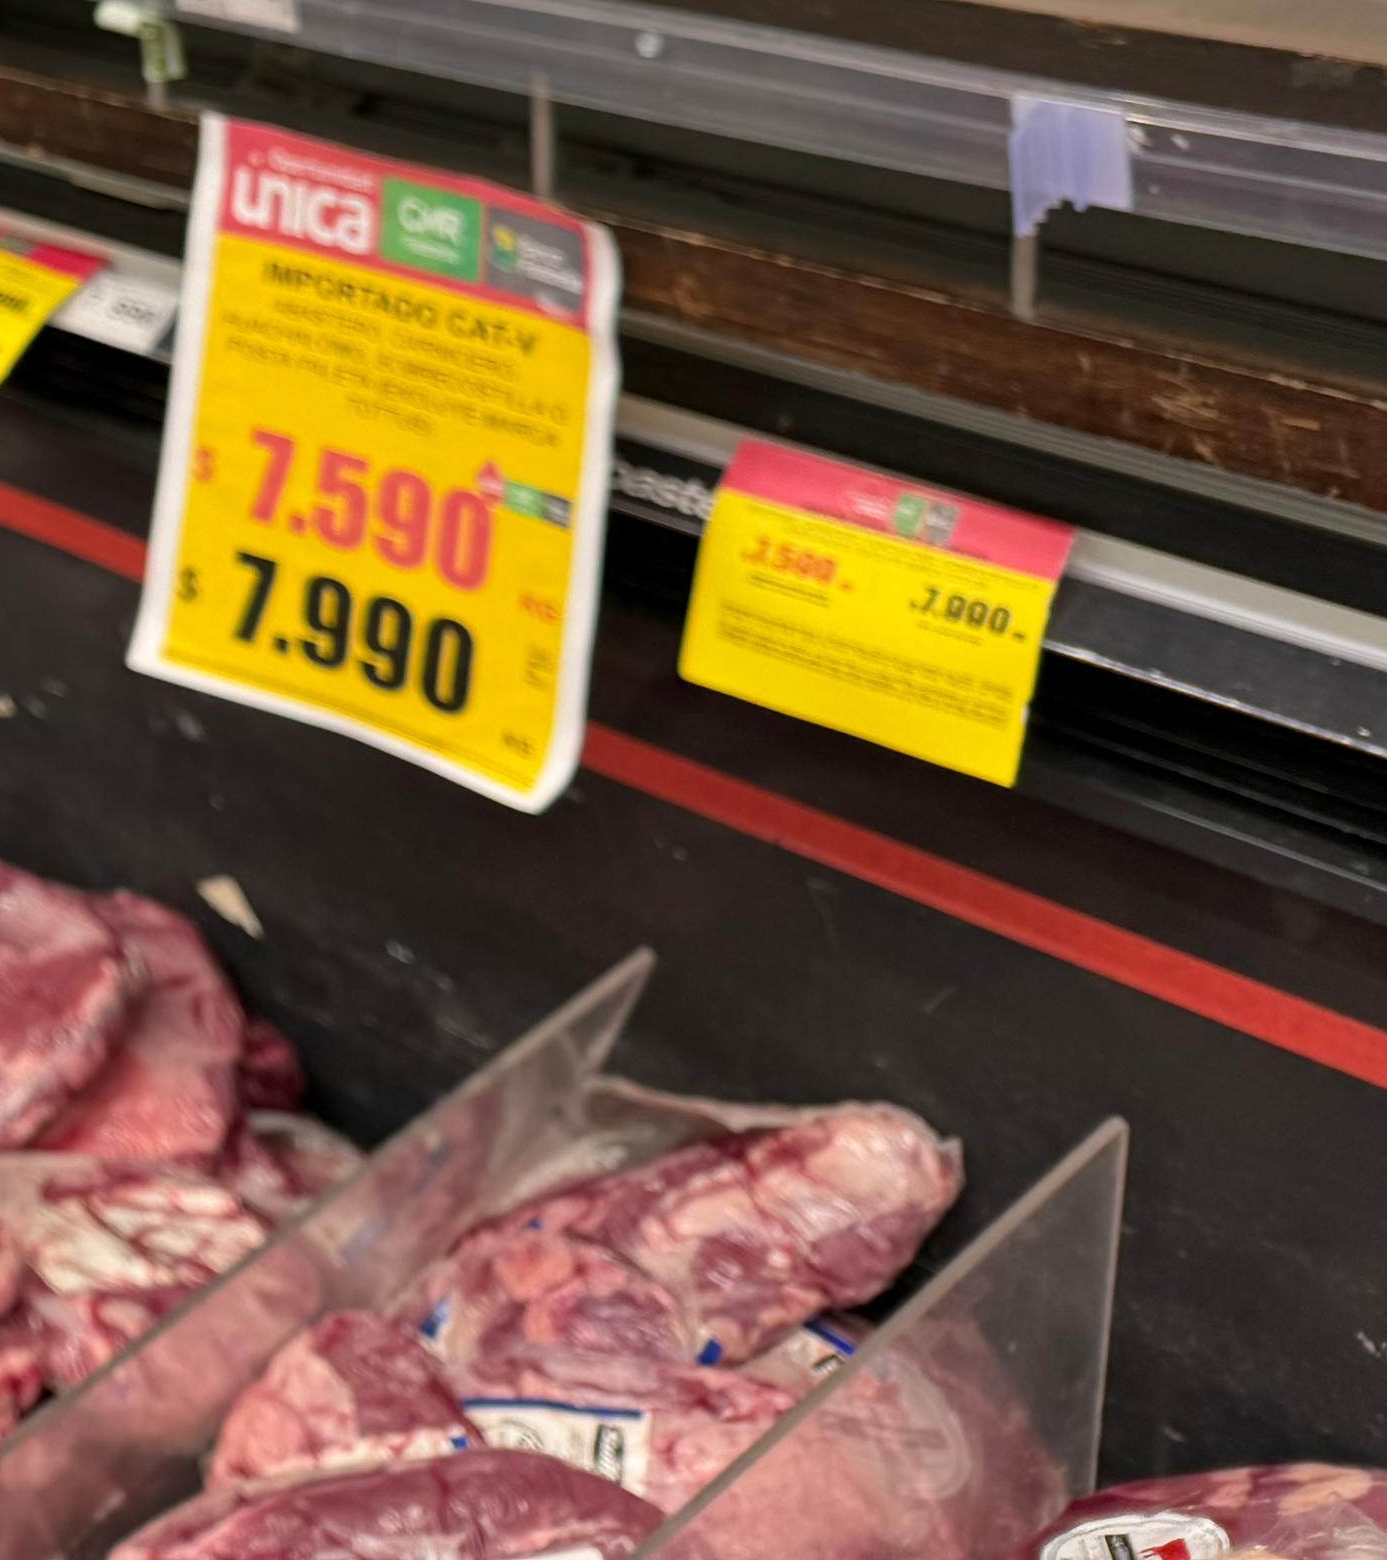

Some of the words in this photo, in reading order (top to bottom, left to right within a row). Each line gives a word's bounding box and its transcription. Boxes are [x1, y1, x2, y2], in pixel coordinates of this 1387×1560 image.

[263, 261, 439, 328] IMPORTADO
[250, 426, 493, 592] 7.590
[235, 548, 474, 714] 7.990
